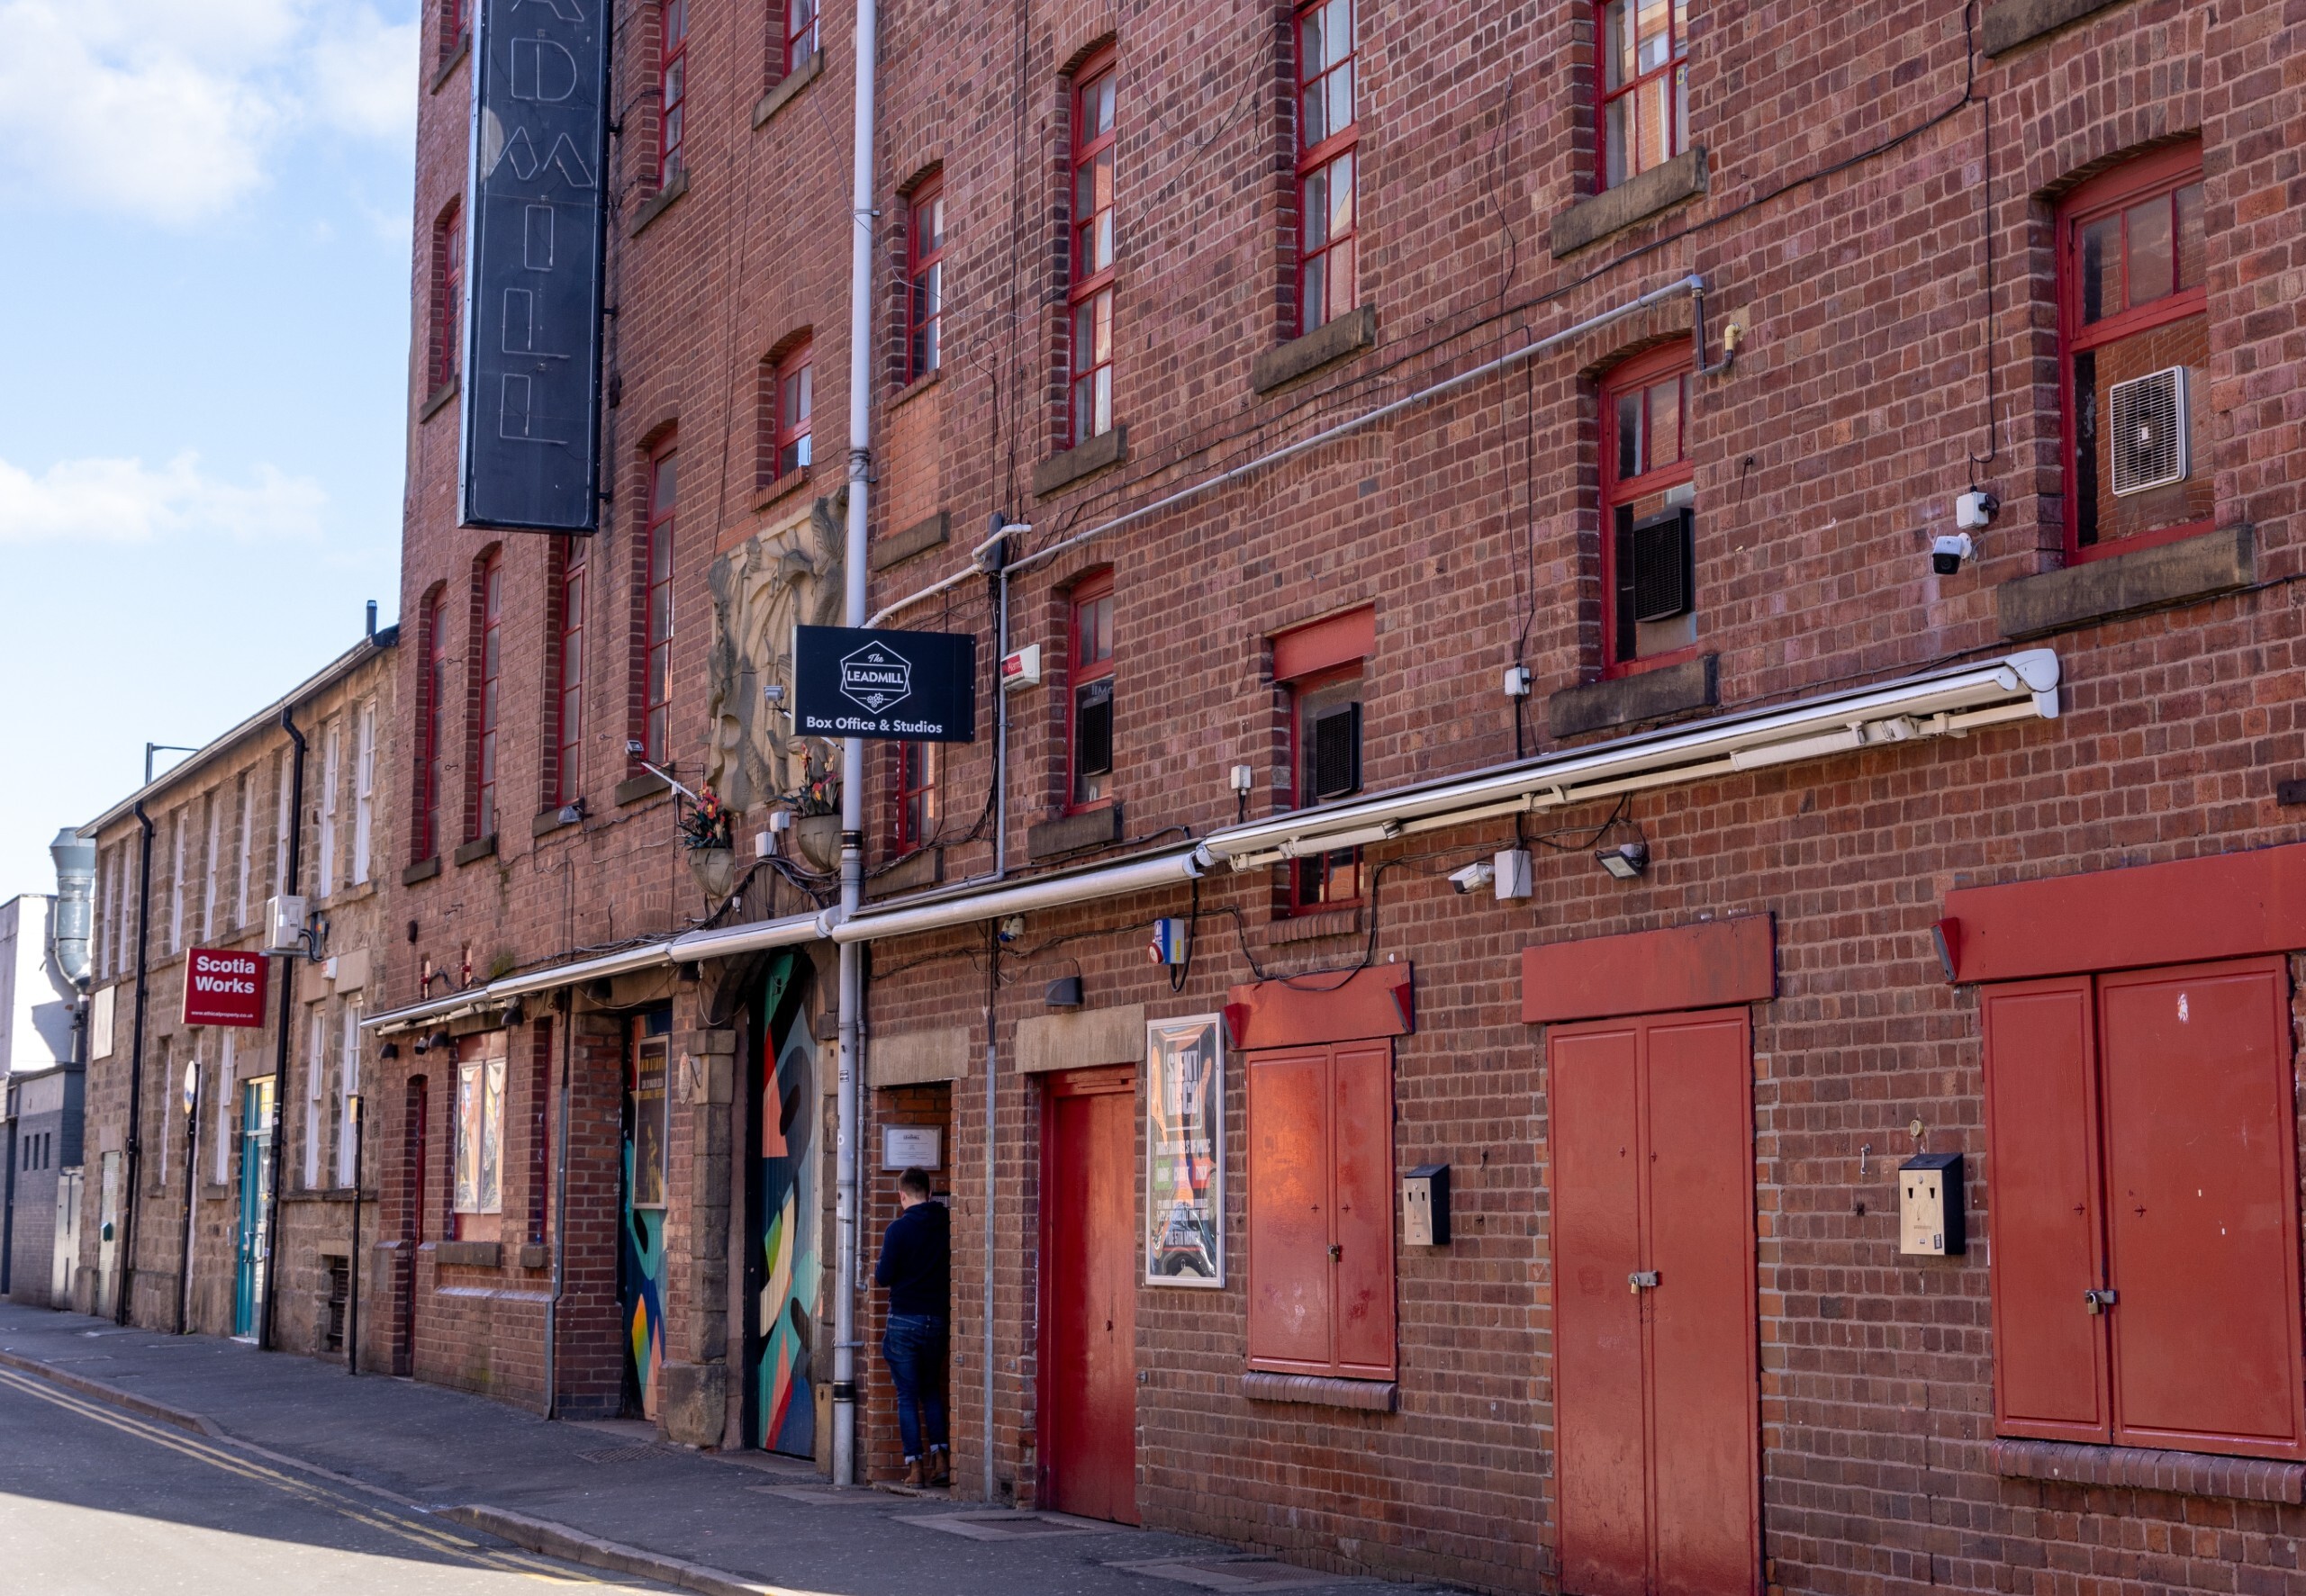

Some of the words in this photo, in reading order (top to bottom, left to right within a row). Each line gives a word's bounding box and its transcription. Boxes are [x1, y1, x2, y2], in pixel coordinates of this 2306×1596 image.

[867, 654, 885, 663] The
[846, 671, 904, 684] LEADMILL
[806, 716, 832, 729] Box
[836, 717, 876, 731] Office
[879, 719, 891, 732] &
[893, 720, 943, 734] Studios
[196, 955, 256, 974] Scotia
[194, 976, 255, 994] Works
[191, 1010, 254, 1019] www.ethicalproperty.co.uk
[1167, 1050, 1198, 1082] SENT
[1167, 1081, 1198, 1115] DCO
